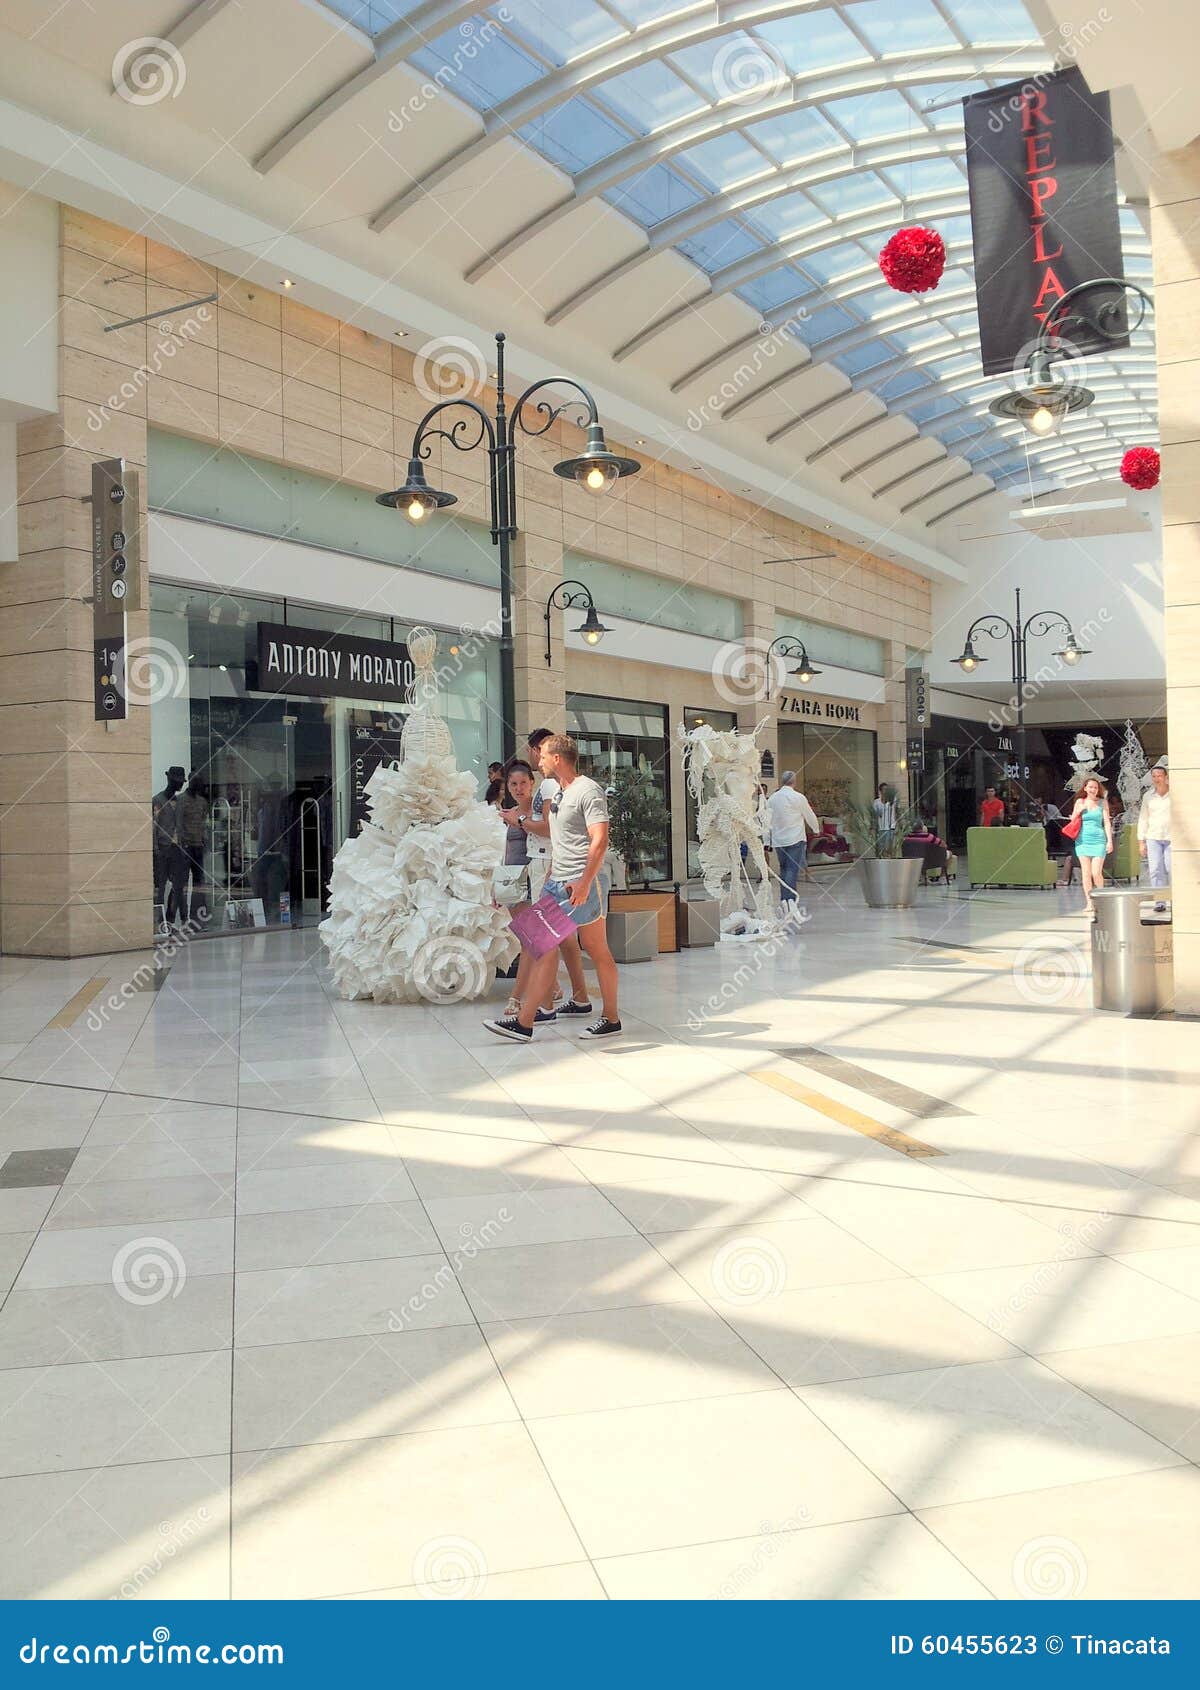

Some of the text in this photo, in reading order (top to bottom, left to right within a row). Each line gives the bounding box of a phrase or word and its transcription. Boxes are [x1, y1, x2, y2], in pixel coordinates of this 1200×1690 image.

[348, 653, 414, 688] MORATO
[780, 695, 821, 716] ZARA
[998, 737, 1013, 750] ZARA
